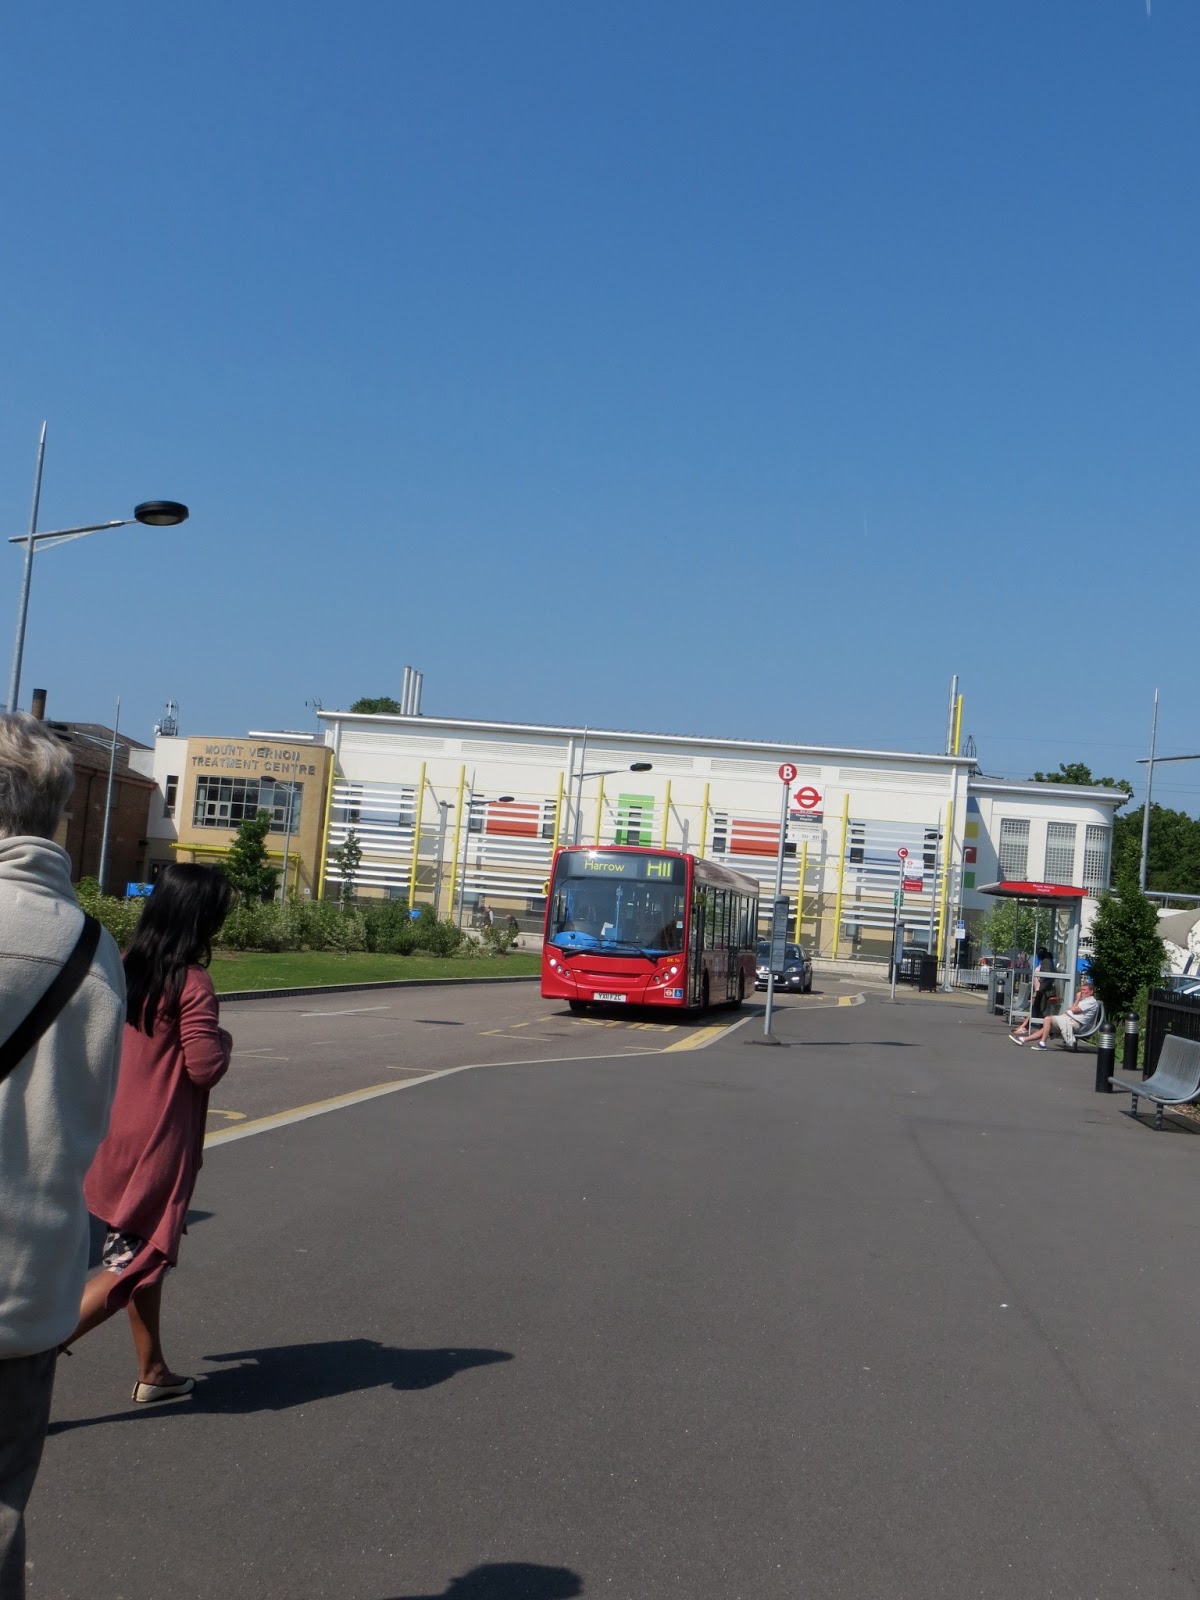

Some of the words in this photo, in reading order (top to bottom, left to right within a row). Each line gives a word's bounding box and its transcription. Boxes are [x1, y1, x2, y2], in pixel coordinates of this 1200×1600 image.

[205, 745, 243, 757] MOUNT
[249, 747, 300, 761] VERNON
[192, 756, 259, 770] TREATMENT
[264, 761, 316, 775] CENTRE
[783, 766, 793, 779] B
[898, 849, 906, 857] C
[584, 859, 625, 872] Harrow
[647, 860, 671, 877] H11
